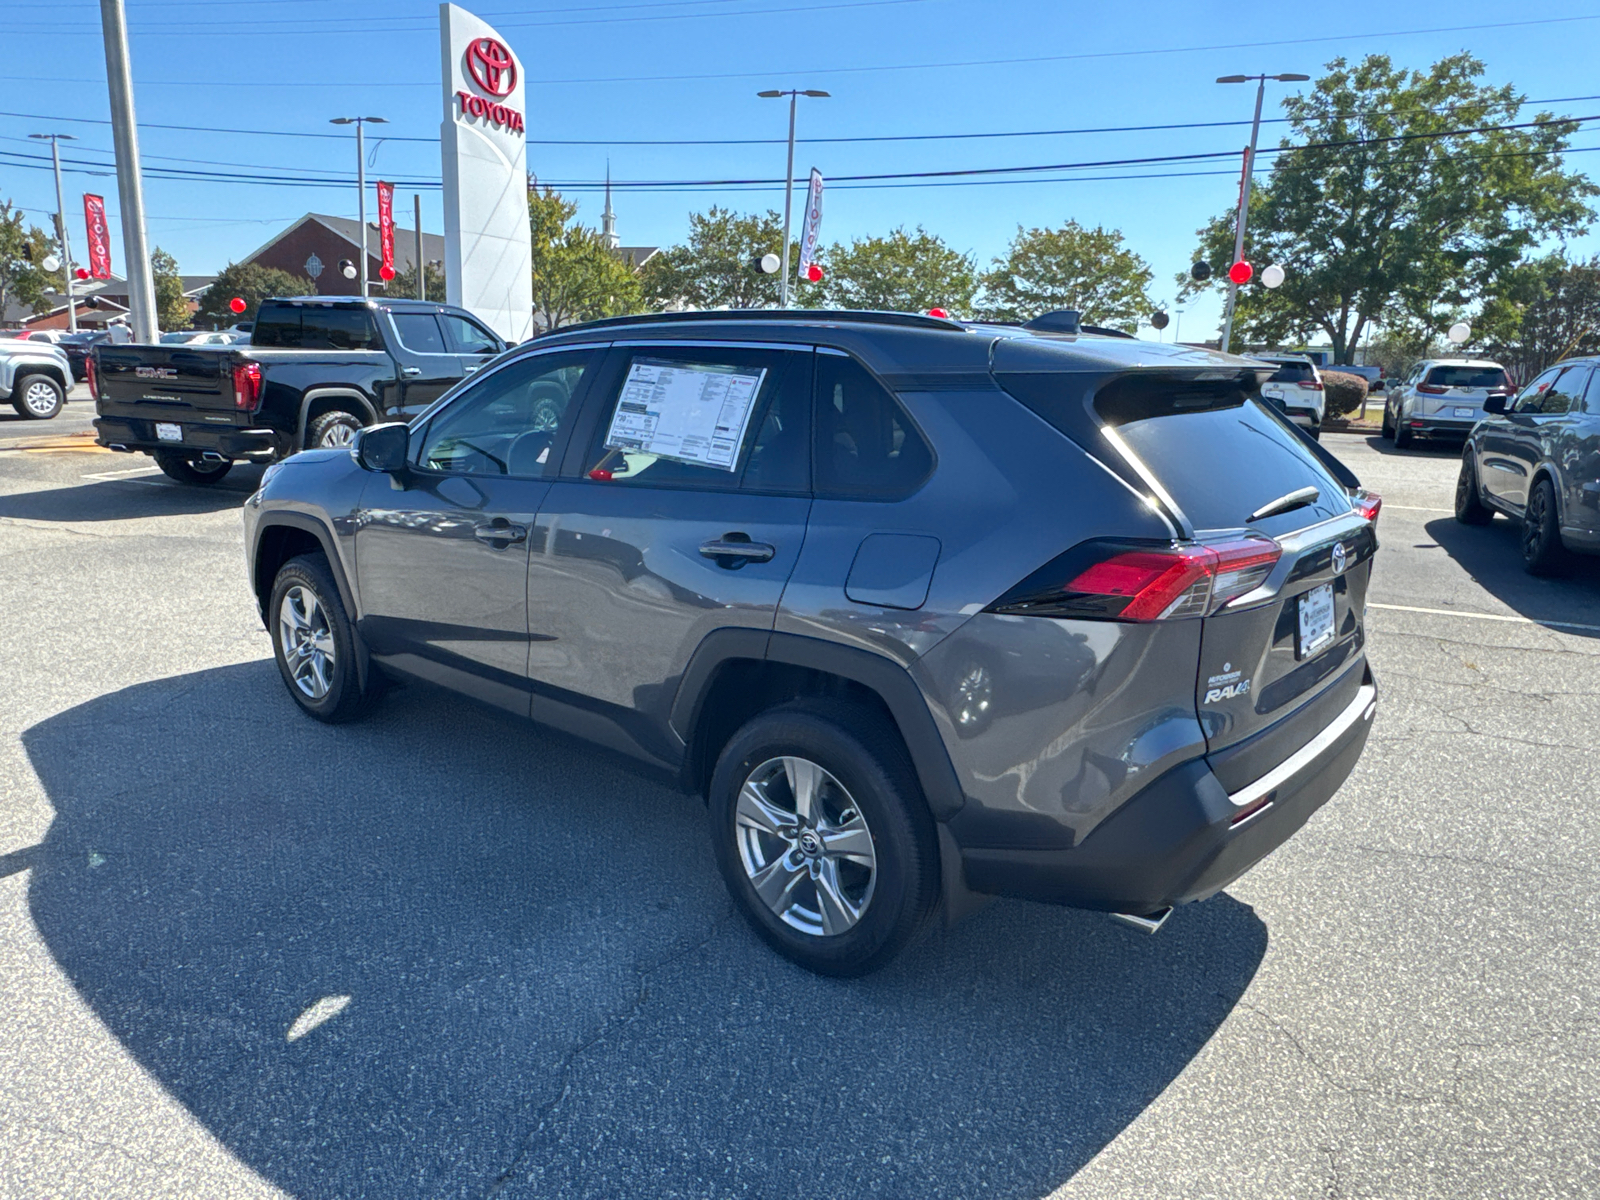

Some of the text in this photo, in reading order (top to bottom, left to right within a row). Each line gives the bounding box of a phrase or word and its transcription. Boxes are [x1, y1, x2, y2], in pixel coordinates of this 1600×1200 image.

[456, 91, 525, 133] TOYOTA
[93, 213, 107, 275] TOYOTA
[135, 366, 178, 379] GMC
[1204, 679, 1250, 704] RAV4
